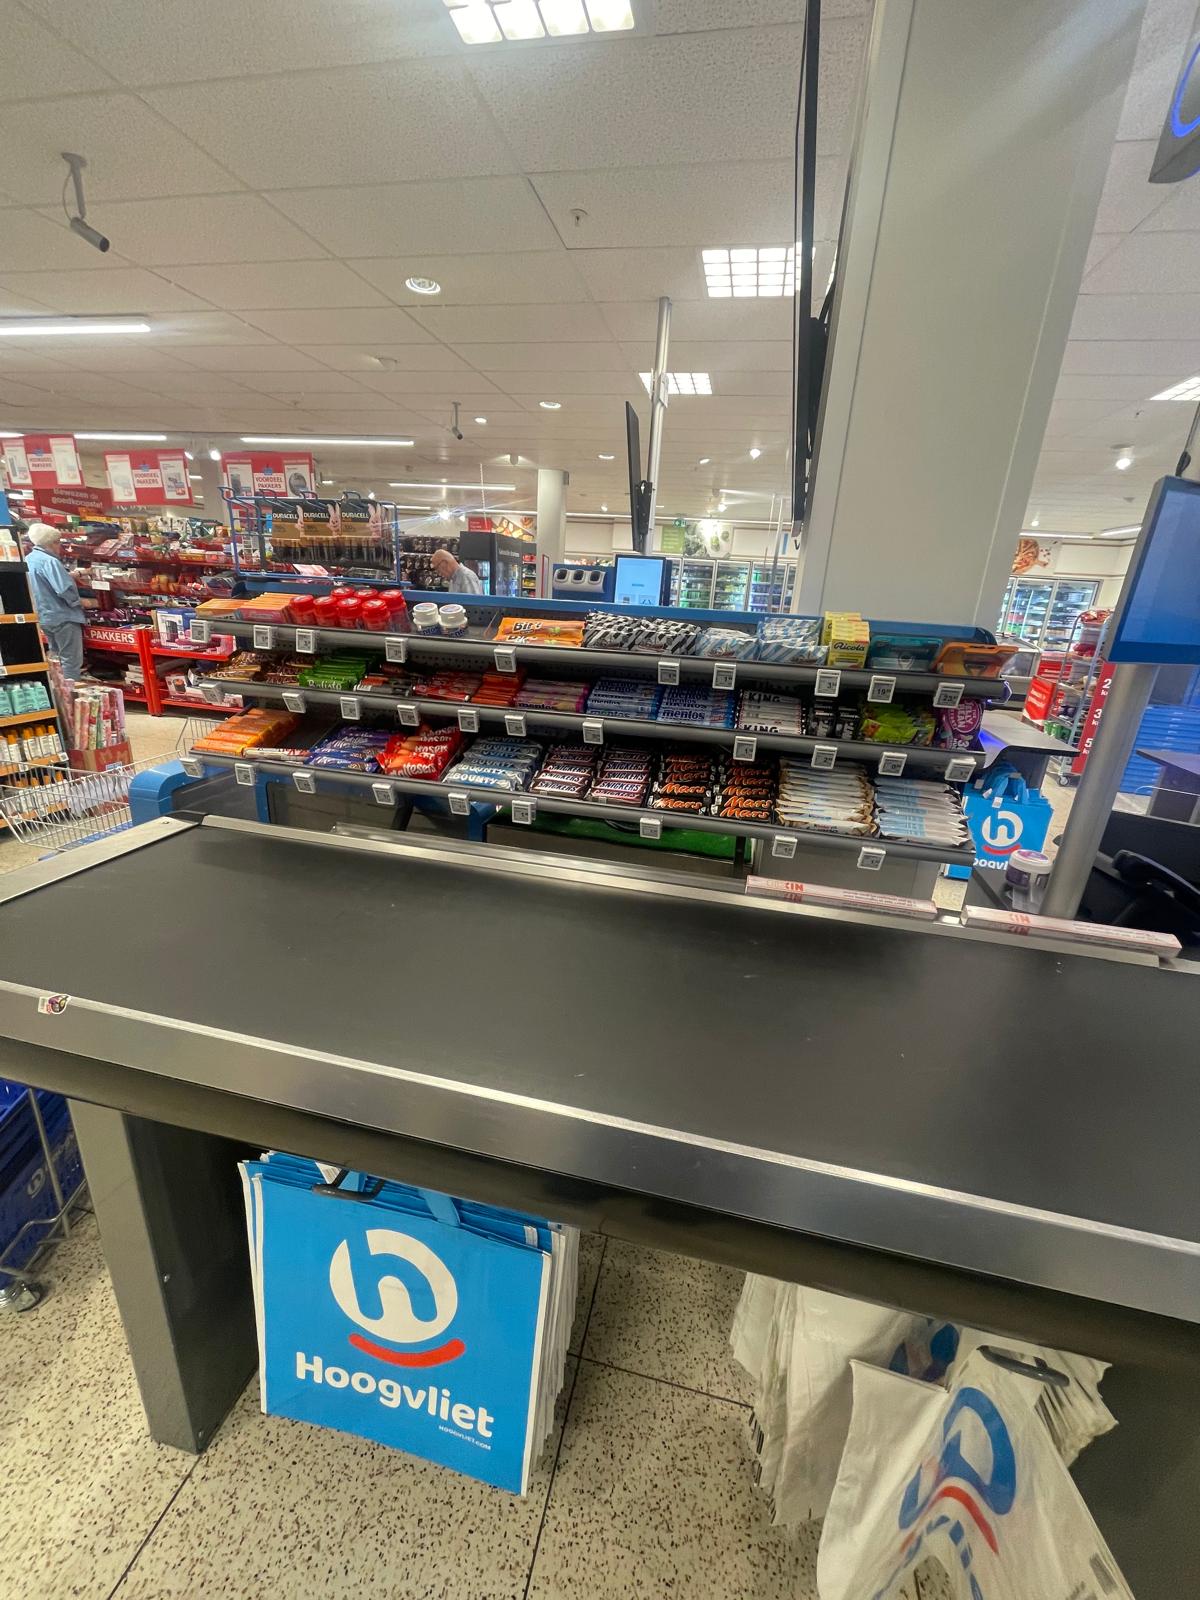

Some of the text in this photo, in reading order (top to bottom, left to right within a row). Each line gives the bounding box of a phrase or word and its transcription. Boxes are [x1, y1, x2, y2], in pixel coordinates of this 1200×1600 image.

[272, 512, 298, 520] DURACELL
[341, 511, 369, 519] DURACELL
[90, 629, 135, 643] PAKKERS
[833, 641, 865, 651] Ricola
[1102, 678, 1112, 689] 2
[748, 691, 780, 703] KING
[662, 708, 705, 720] mentos
[1093, 708, 1102, 719] 3
[743, 724, 779, 733] KING
[1084, 737, 1093, 748] 5
[461, 764, 506, 775] BOUNTY
[453, 772, 500, 785] BOUNTY
[539, 781, 577, 792] SNICKERS
[600, 781, 640, 792] SNICKERS
[660, 782, 706, 795] Mars
[722, 785, 769, 795] Mars
[652, 798, 703, 809] Mars
[723, 795, 773, 808] Mars
[720, 806, 770, 819] Mars
[295, 1351, 495, 1438] Hoogvliet
